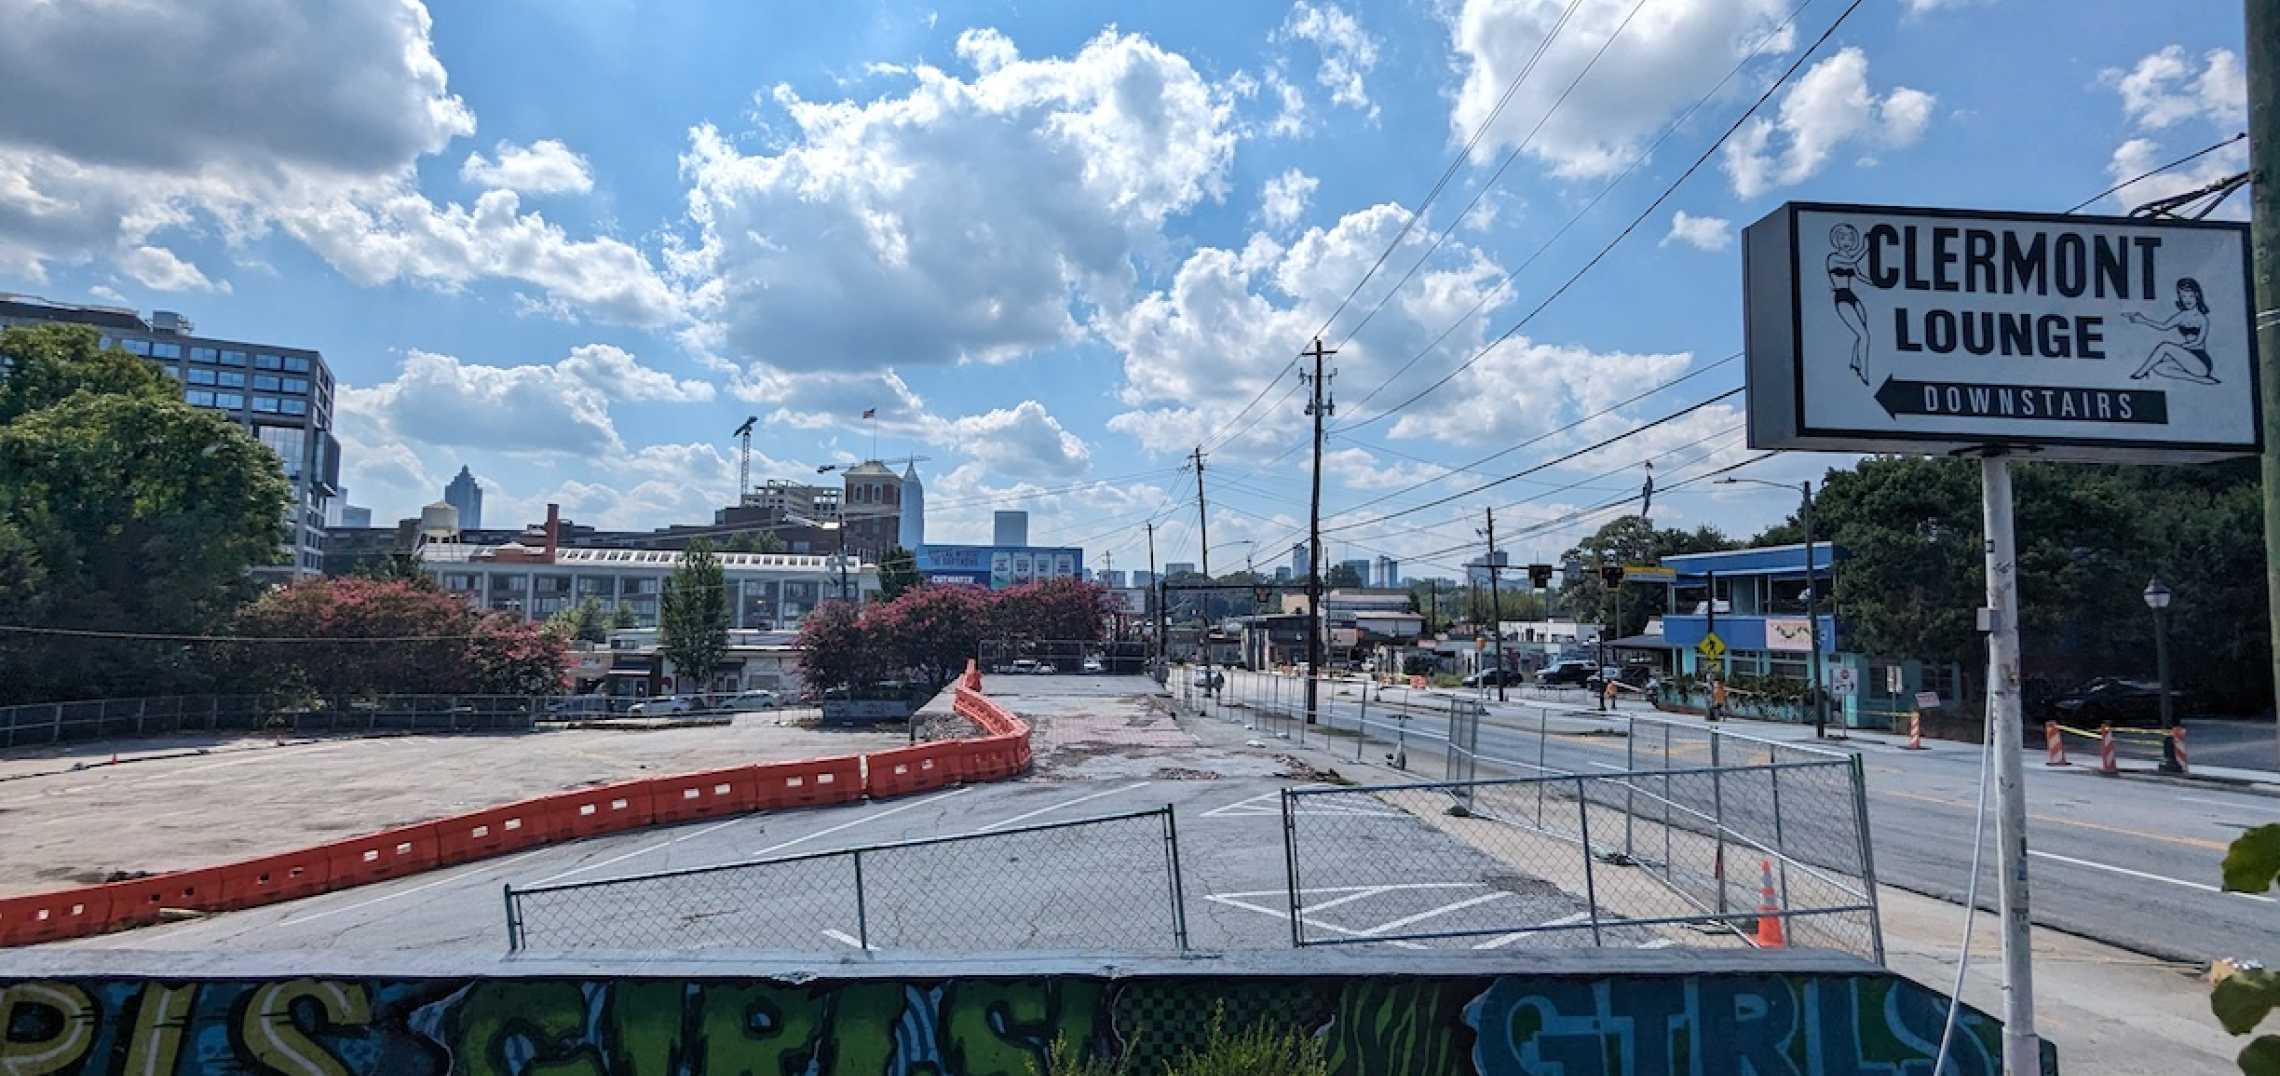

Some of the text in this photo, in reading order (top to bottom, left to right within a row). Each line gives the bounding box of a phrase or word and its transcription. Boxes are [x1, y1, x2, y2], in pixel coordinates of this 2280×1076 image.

[1868, 223, 2162, 301] CLERMONT
[1895, 307, 2106, 360] LOUNGE
[1923, 384, 2133, 420] DOWNSTAIRS
